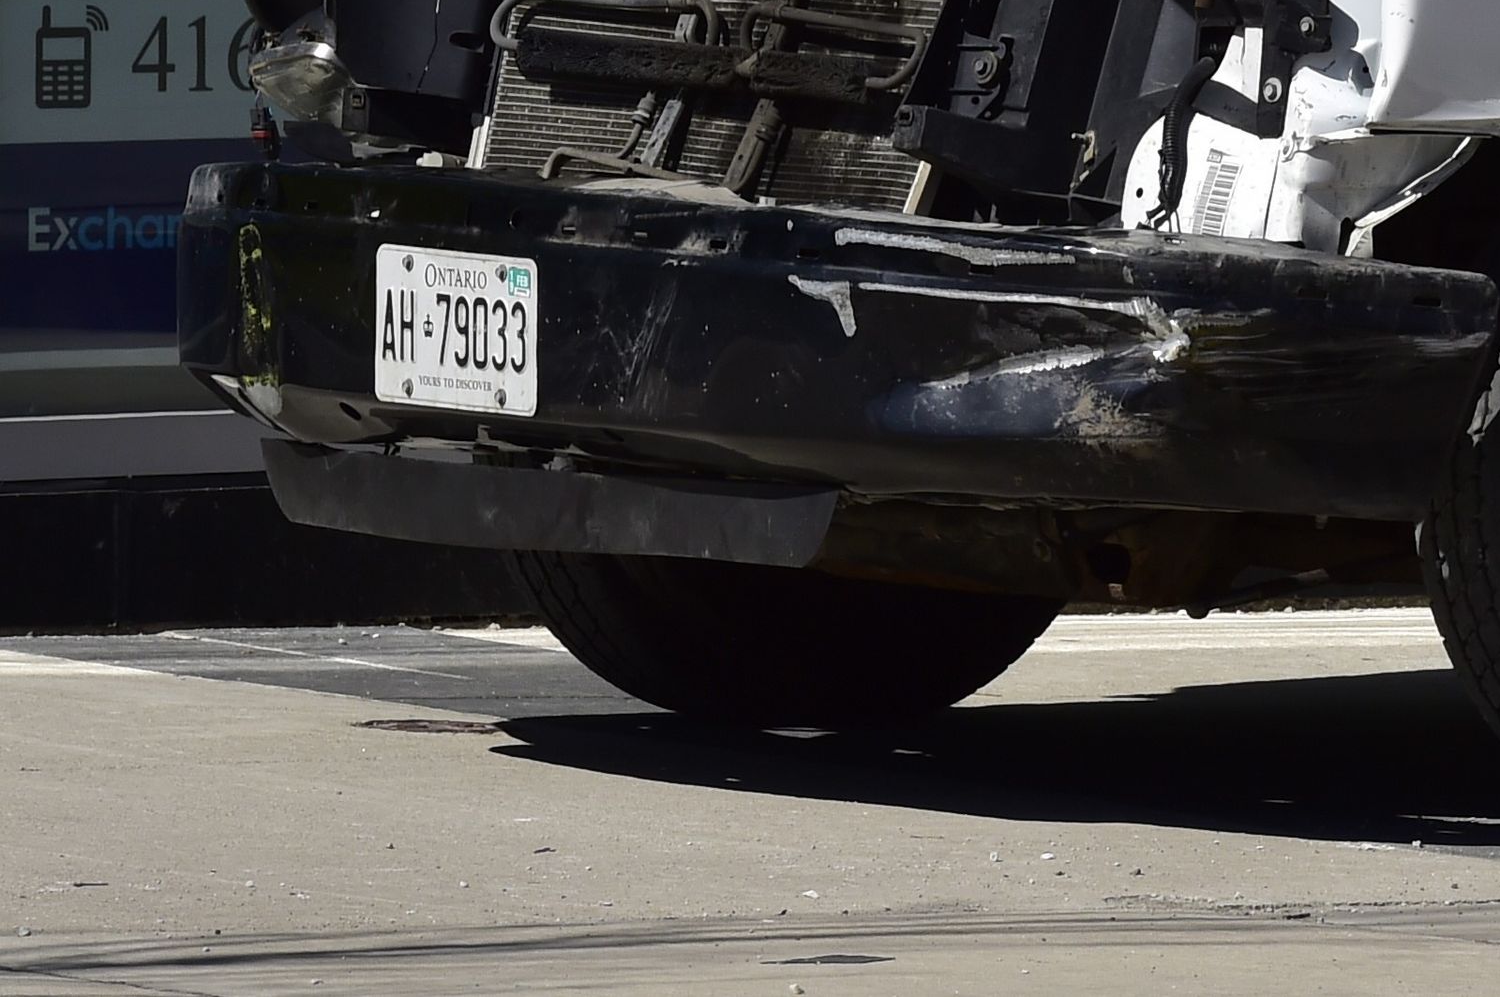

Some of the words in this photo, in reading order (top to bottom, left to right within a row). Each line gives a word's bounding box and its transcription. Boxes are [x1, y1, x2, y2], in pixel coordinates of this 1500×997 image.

[131, 14, 257, 92] 416
[382, 288, 416, 362] AH
[436, 292, 528, 375] 79033
[418, 375, 441, 388] YOURS
[443, 377, 454, 389] TO
[455, 378, 493, 393] DISCOVER
